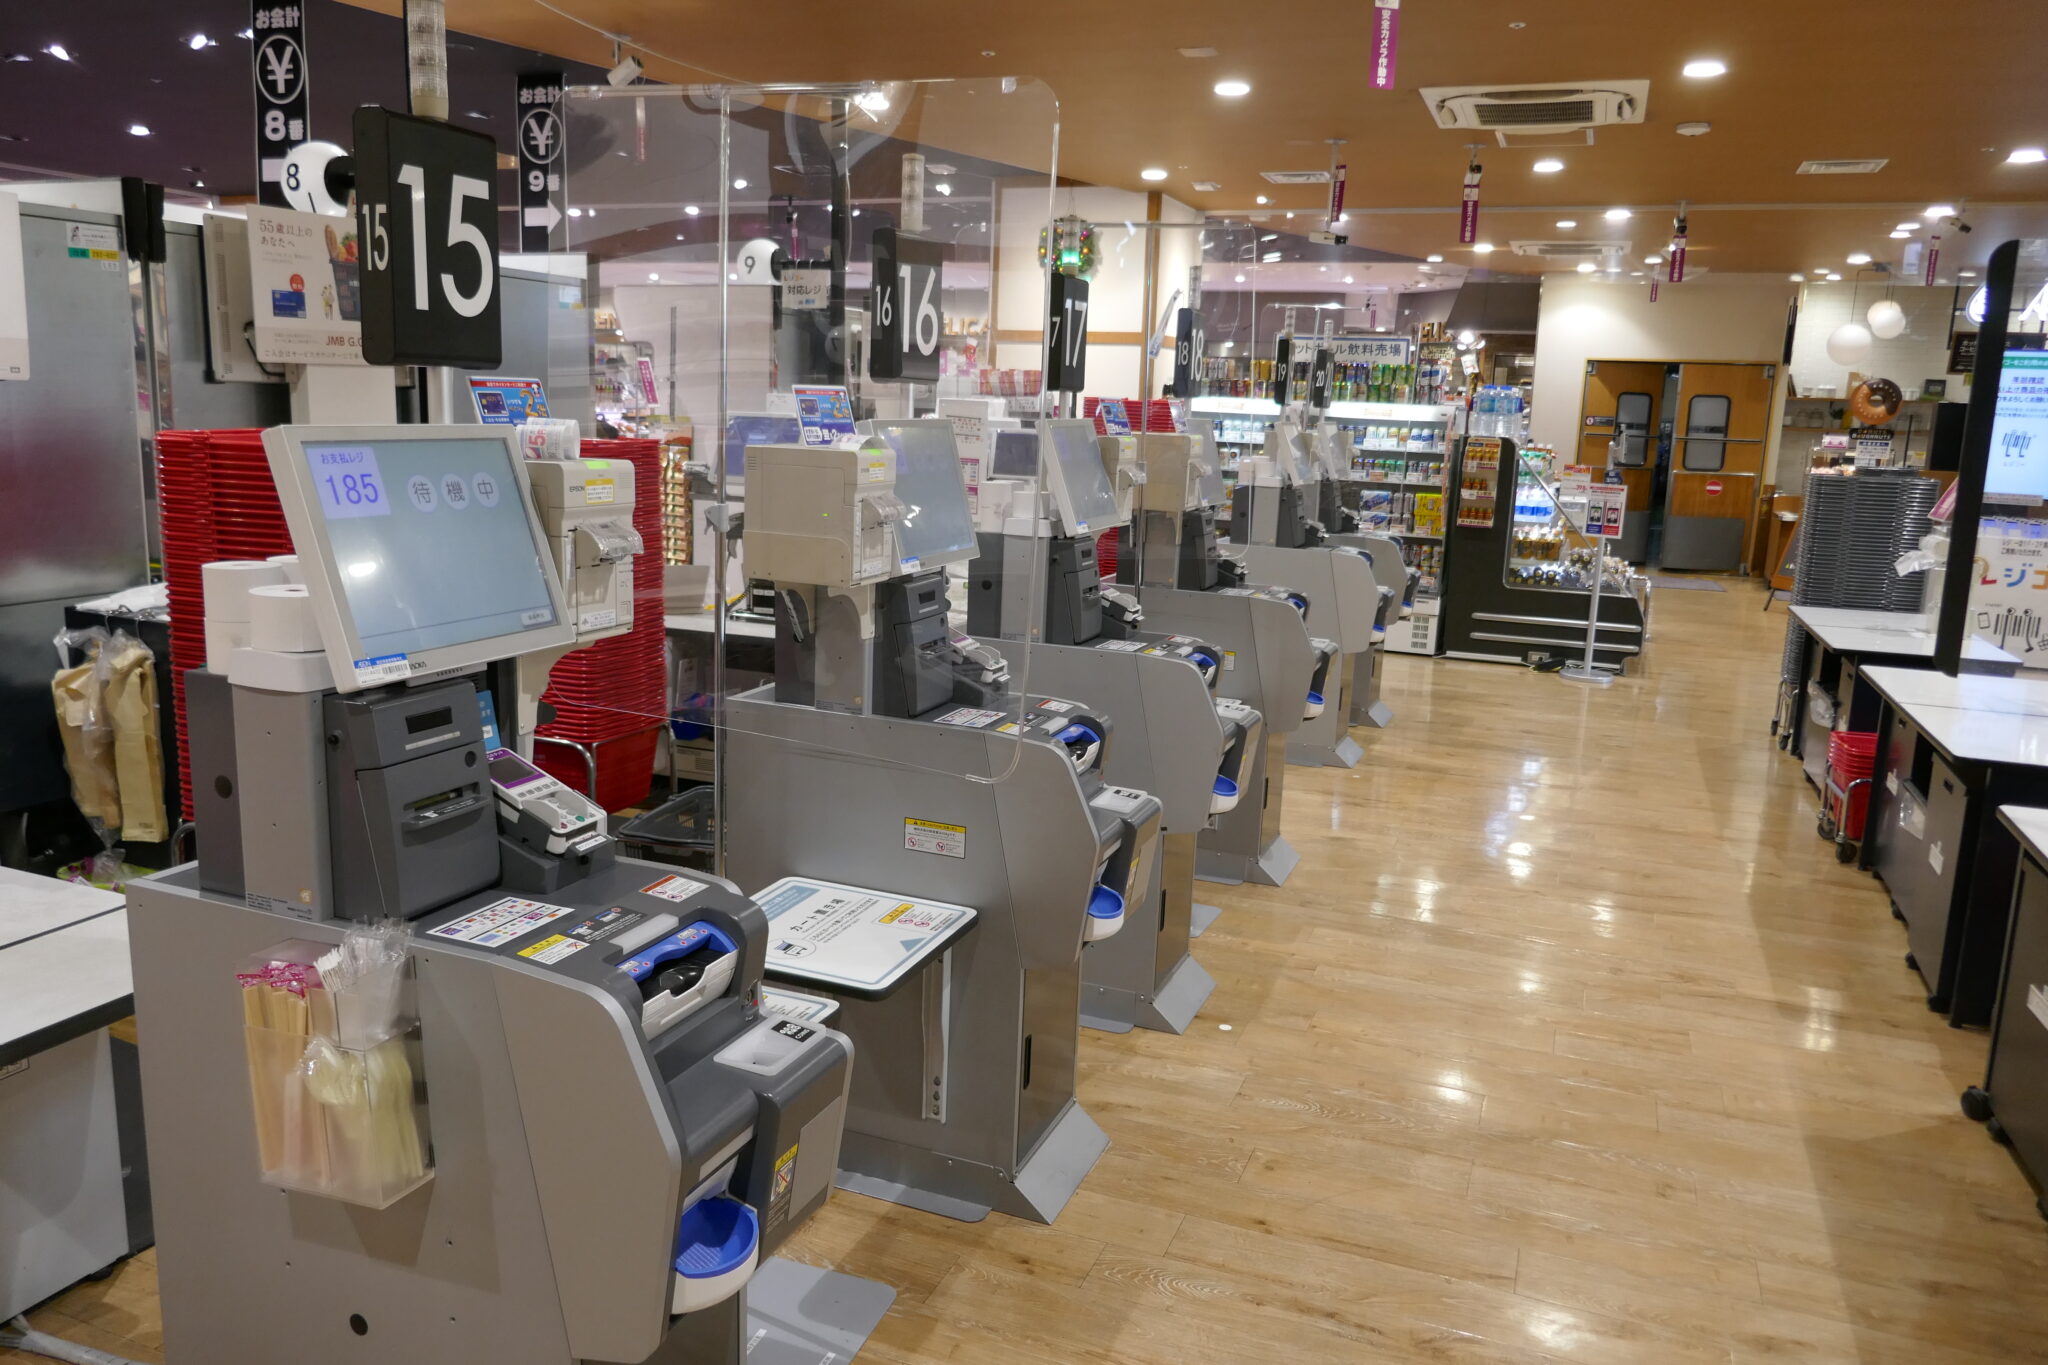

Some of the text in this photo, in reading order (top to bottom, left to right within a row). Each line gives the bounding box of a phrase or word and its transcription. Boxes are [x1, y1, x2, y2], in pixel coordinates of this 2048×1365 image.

[255, 6, 300, 29] お会計
[519, 86, 562, 104] お会計
[265, 110, 304, 141] 8番
[286, 163, 301, 192] 8
[528, 170, 561, 192] 9番
[362, 203, 389, 271] 15
[397, 163, 494, 318] 15
[744, 255, 756, 275] 9
[875, 285, 892, 327] 16
[899, 264, 939, 357] 16
[1051, 316, 1061, 348] 7
[1065, 298, 1088, 369] 17
[1177, 342, 1189, 366] 18
[1190, 329, 1204, 382] 18
[1277, 363, 1287, 381] 19
[1315, 370, 1324, 386] 20
[321, 452, 364, 465] お支払レジ
[326, 473, 379, 506] 185
[412, 479, 494, 505] 待機中
